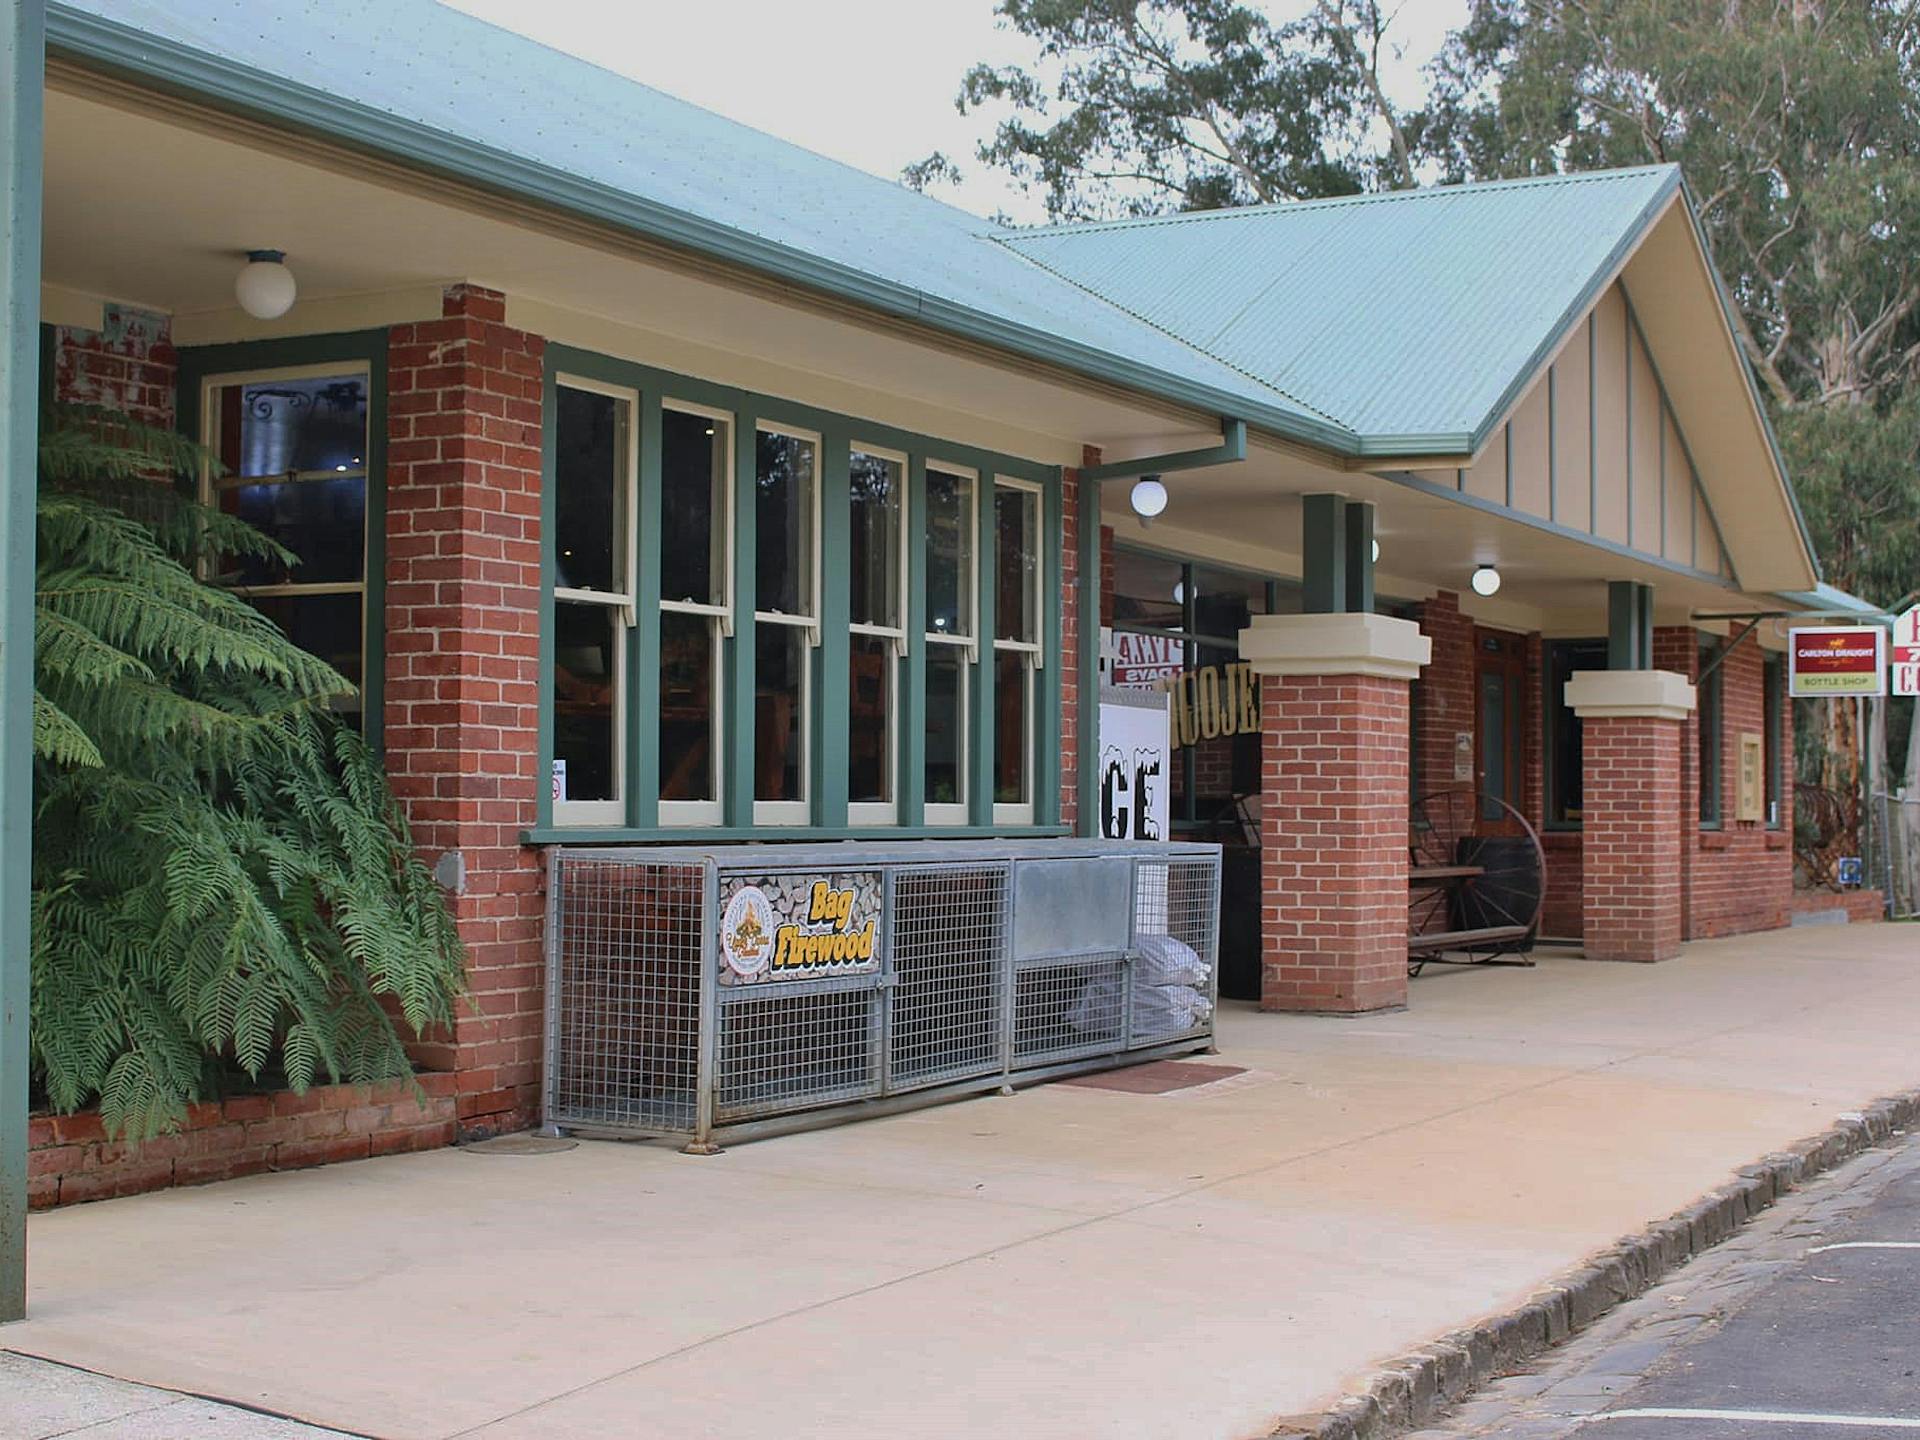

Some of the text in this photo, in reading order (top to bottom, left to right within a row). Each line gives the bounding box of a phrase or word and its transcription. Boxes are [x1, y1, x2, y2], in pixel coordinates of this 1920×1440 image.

[1798, 648, 1874, 658] CARLTON DRAUGHT
[1804, 677, 1869, 686] BOTTLE SHOP
[1101, 745, 1161, 840] CE
[808, 881, 854, 931] Bag
[773, 920, 875, 969] Firewood
